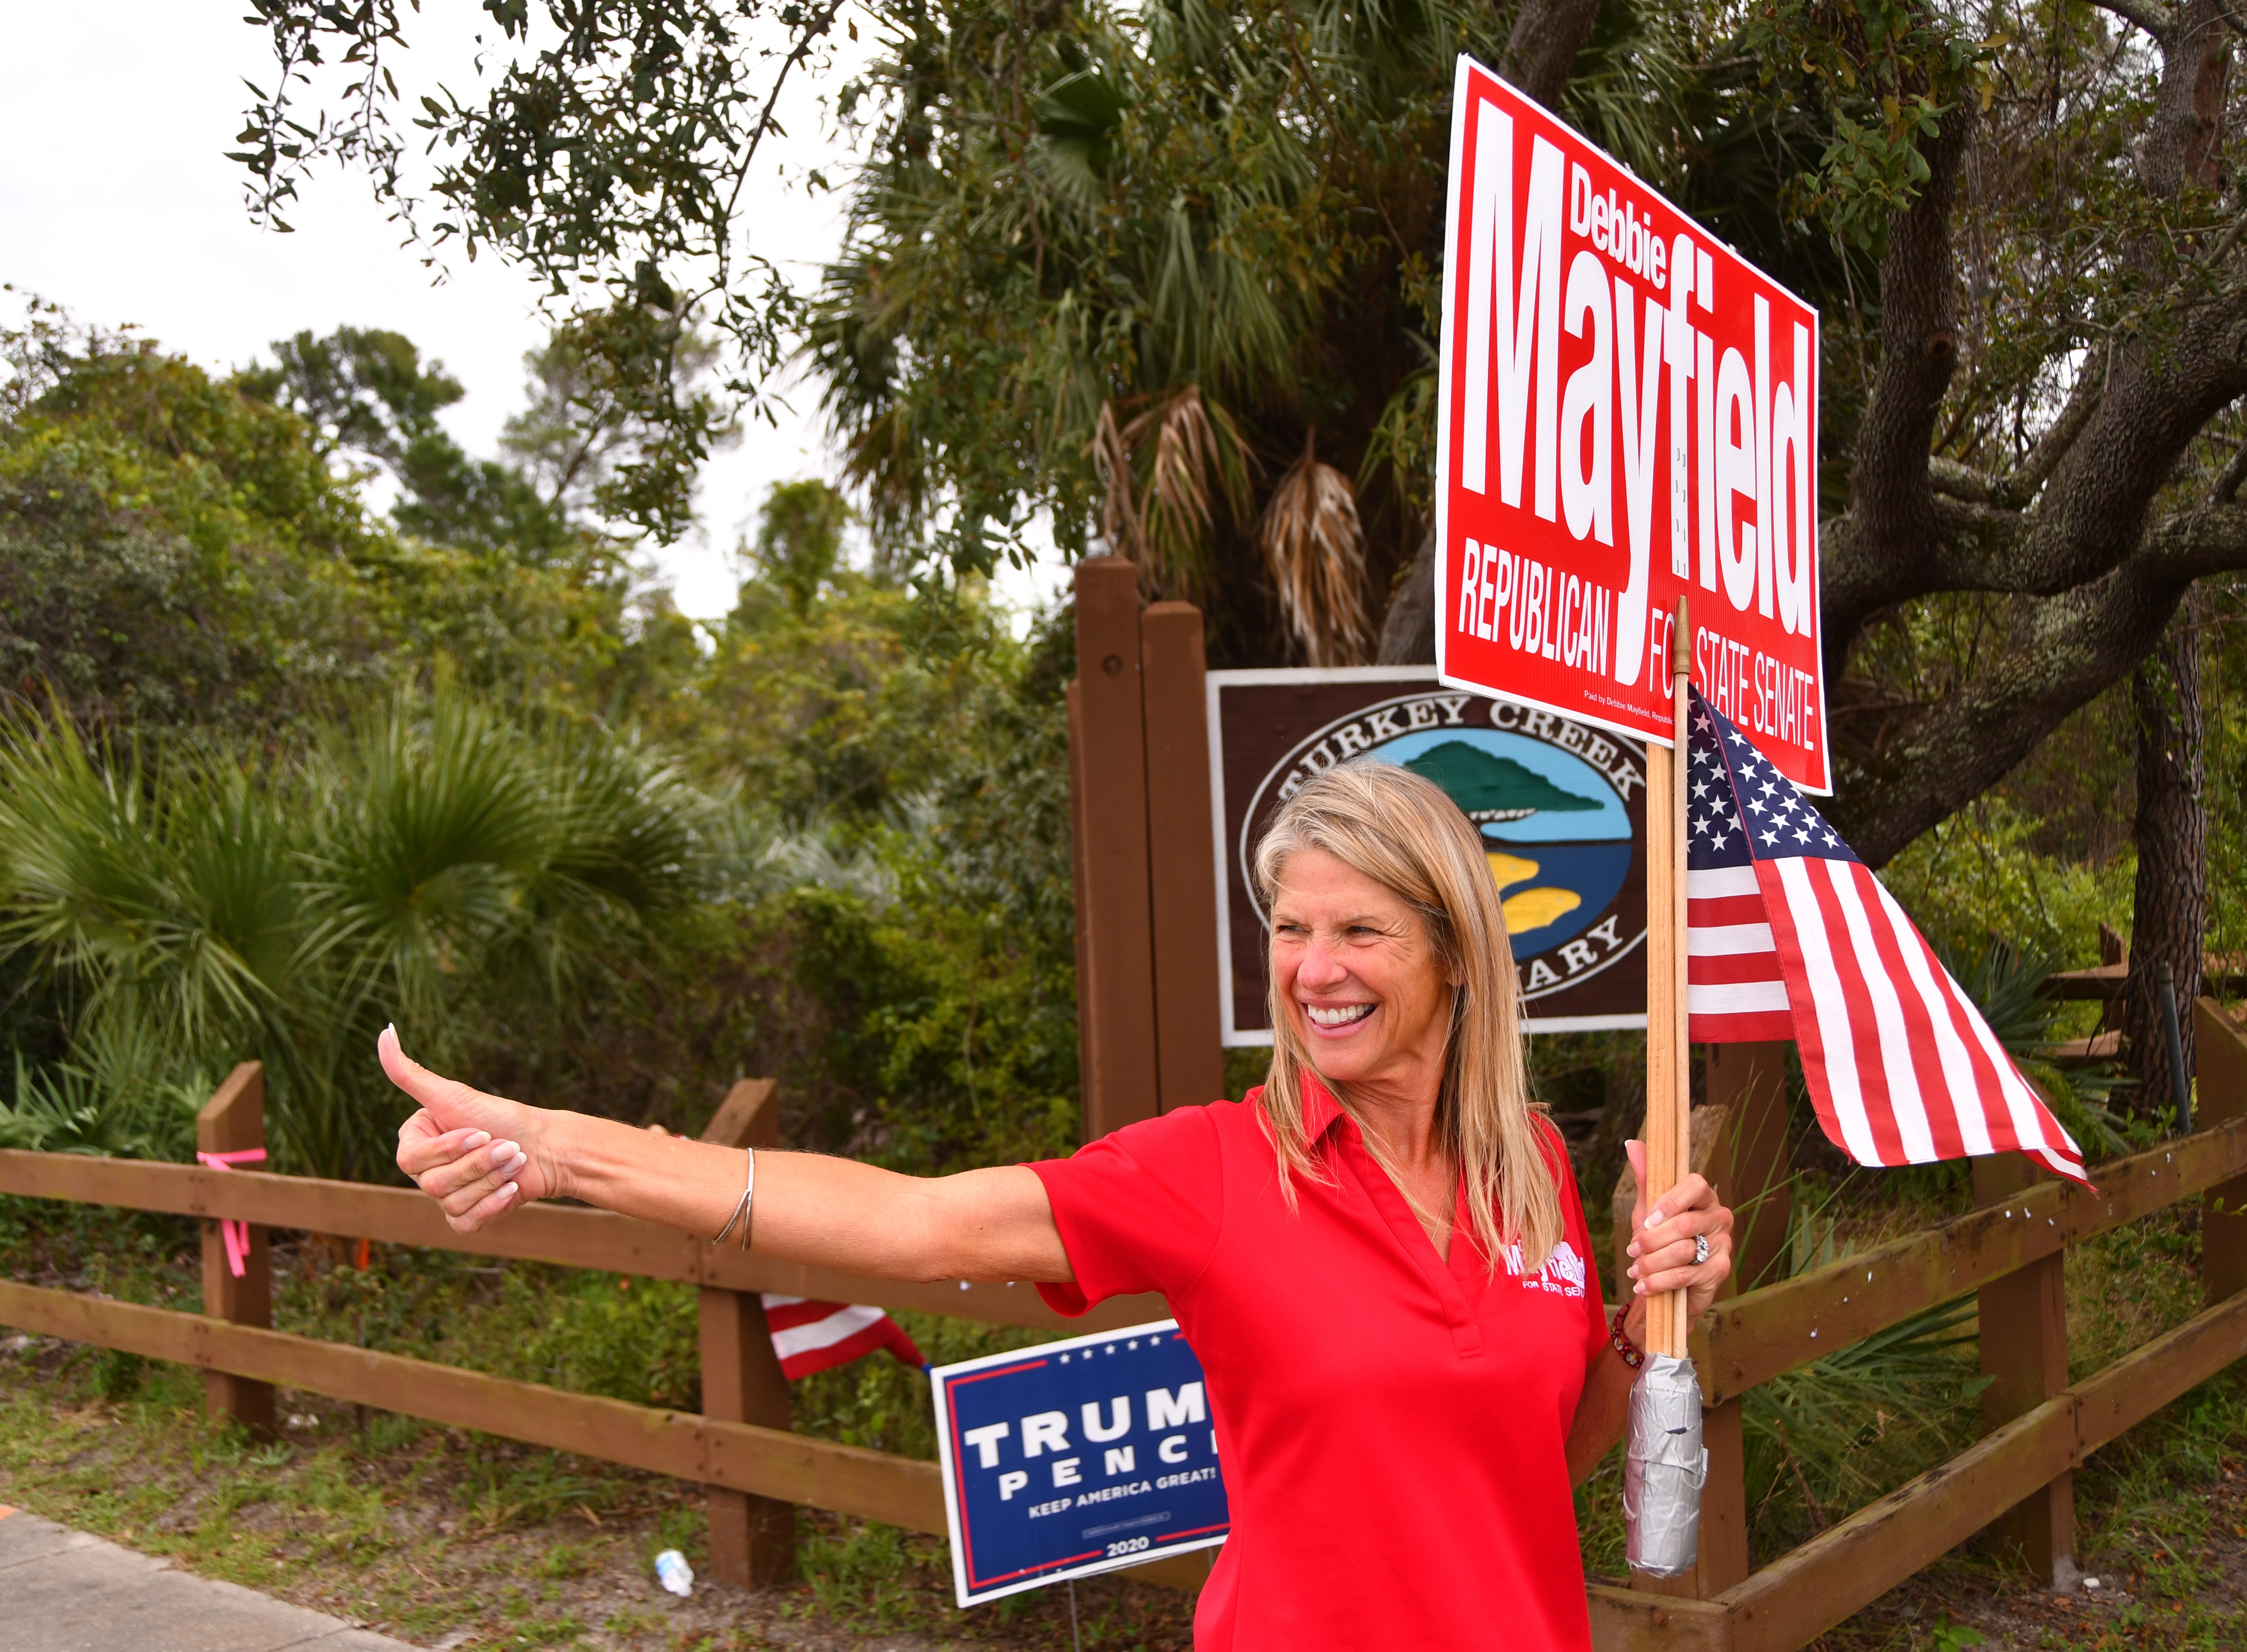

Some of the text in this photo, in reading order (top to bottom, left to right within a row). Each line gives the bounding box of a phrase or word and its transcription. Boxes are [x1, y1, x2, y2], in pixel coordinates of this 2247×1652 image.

[1570, 161, 1666, 290] Debbie
[1462, 97, 1811, 686] Mayfield
[1458, 537, 1610, 676] REPUBLICAN
[1584, 690, 1674, 726] Paid by Debbie Mayfield, Republic
[1649, 607, 1813, 751] FO STATE SENATE
[1278, 695, 1646, 802] TURKEY CREEK
[1523, 1281, 1539, 1289] FOR
[964, 1381, 1206, 1469] TRUM
[1028, 1466, 1216, 1519] KEEP AMERICA GREAT!
[1106, 1536, 1150, 1557] 2020
